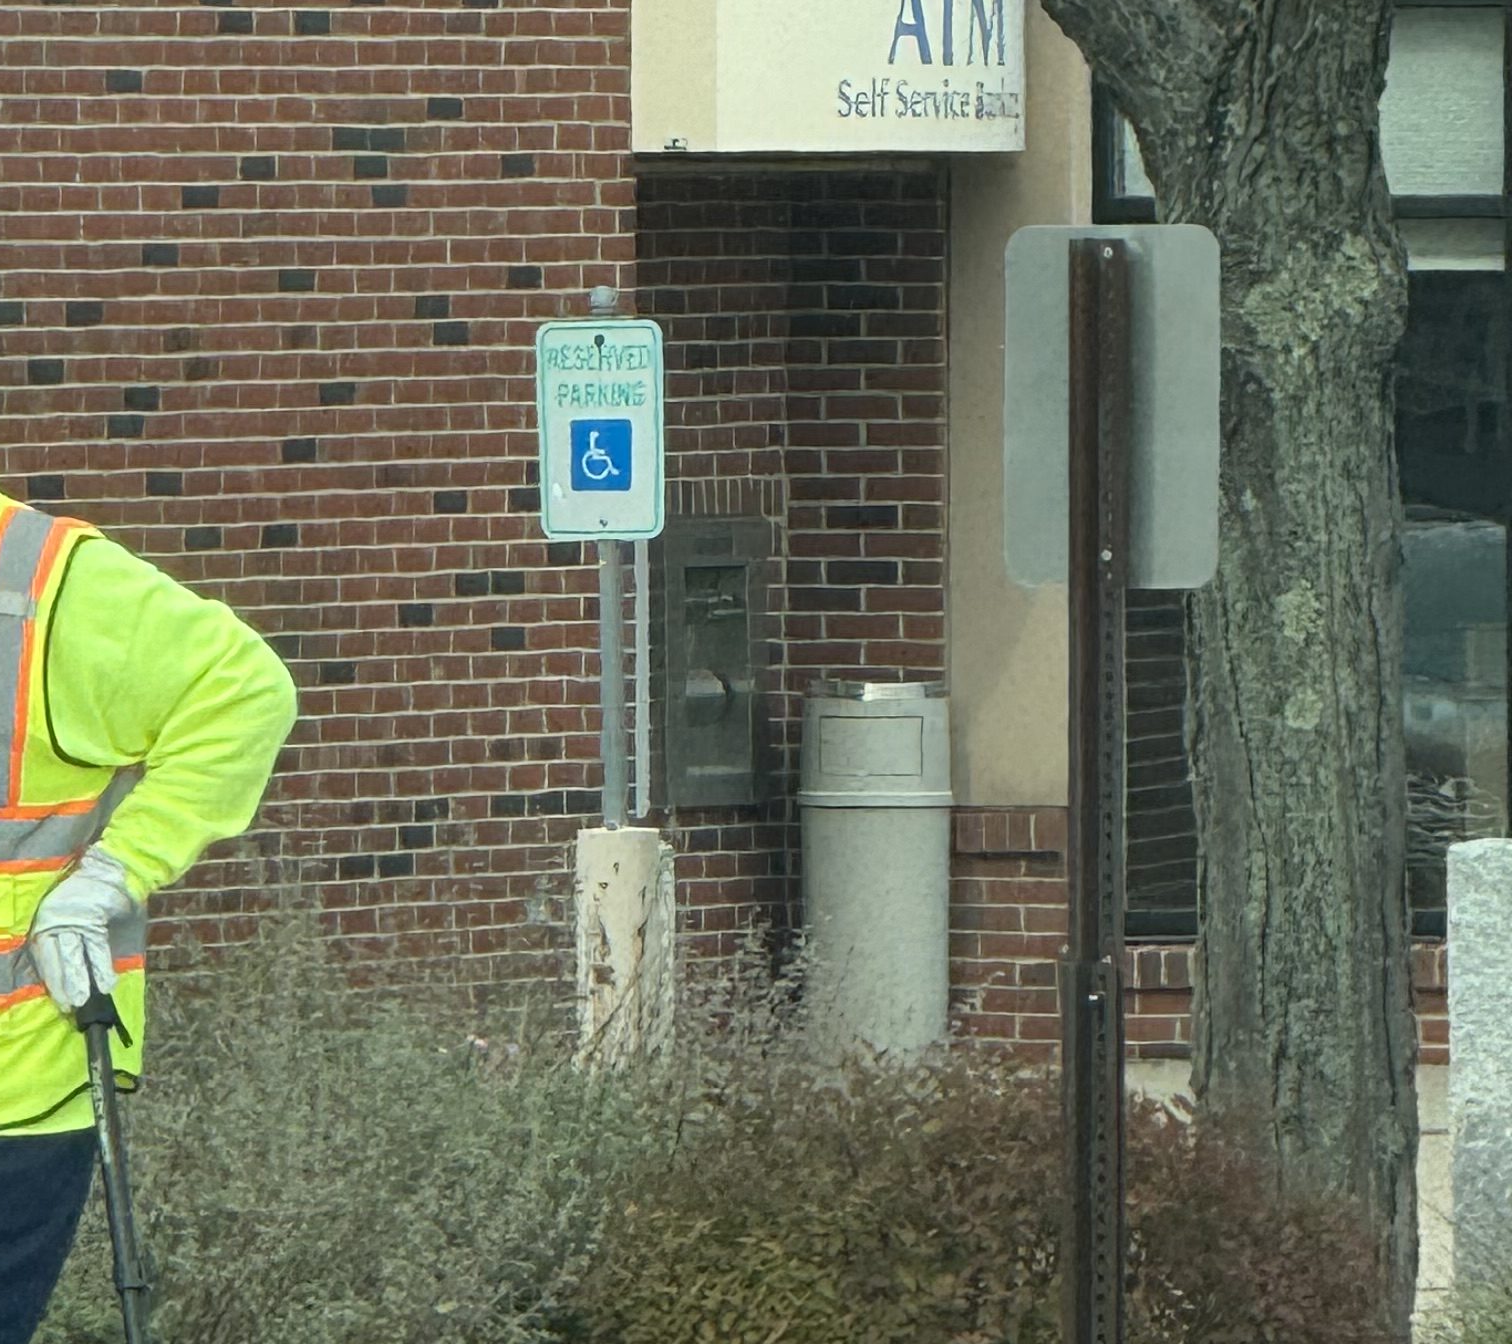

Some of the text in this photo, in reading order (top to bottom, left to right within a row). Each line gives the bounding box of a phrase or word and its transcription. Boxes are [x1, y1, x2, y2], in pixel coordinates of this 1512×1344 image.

[837, 77, 890, 118] Self
[895, 78, 971, 119] Service
[546, 344, 649, 372] RESERVED
[557, 381, 647, 408] PARKING
